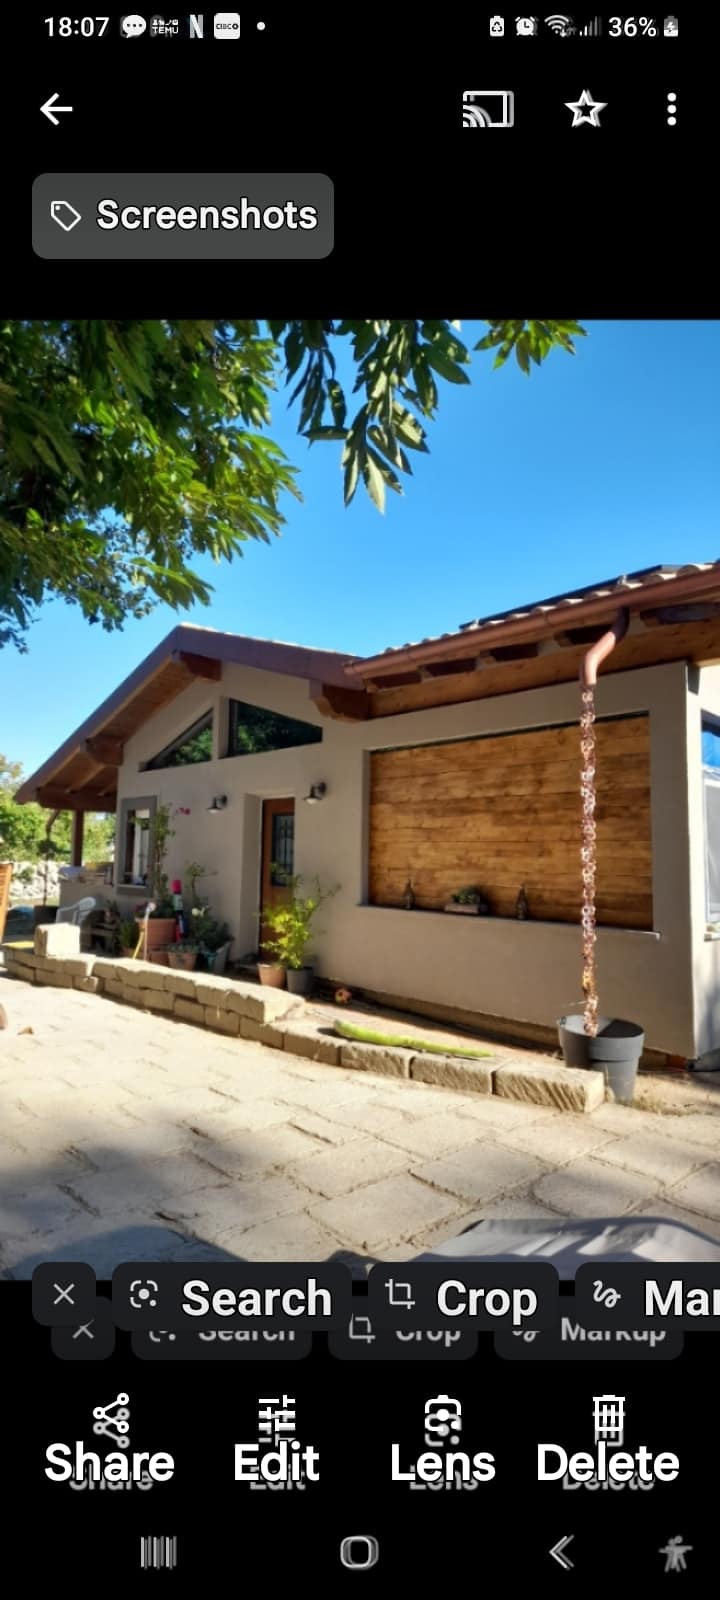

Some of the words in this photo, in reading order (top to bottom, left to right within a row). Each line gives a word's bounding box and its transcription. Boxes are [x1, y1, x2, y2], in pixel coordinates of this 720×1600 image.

[44, 16, 110, 37] 18:07
[151, 26, 179, 34] TEMU
[608, 16, 657, 37] 36%
[97, 197, 317, 230] Screenshots
[182, 1278, 331, 1316] Search
[437, 1279, 537, 1326] Crop
[44, 1440, 175, 1481] Share
[234, 1440, 320, 1481] Edit
[391, 1443, 496, 1481] Lens
[537, 1440, 680, 1481] Delete
